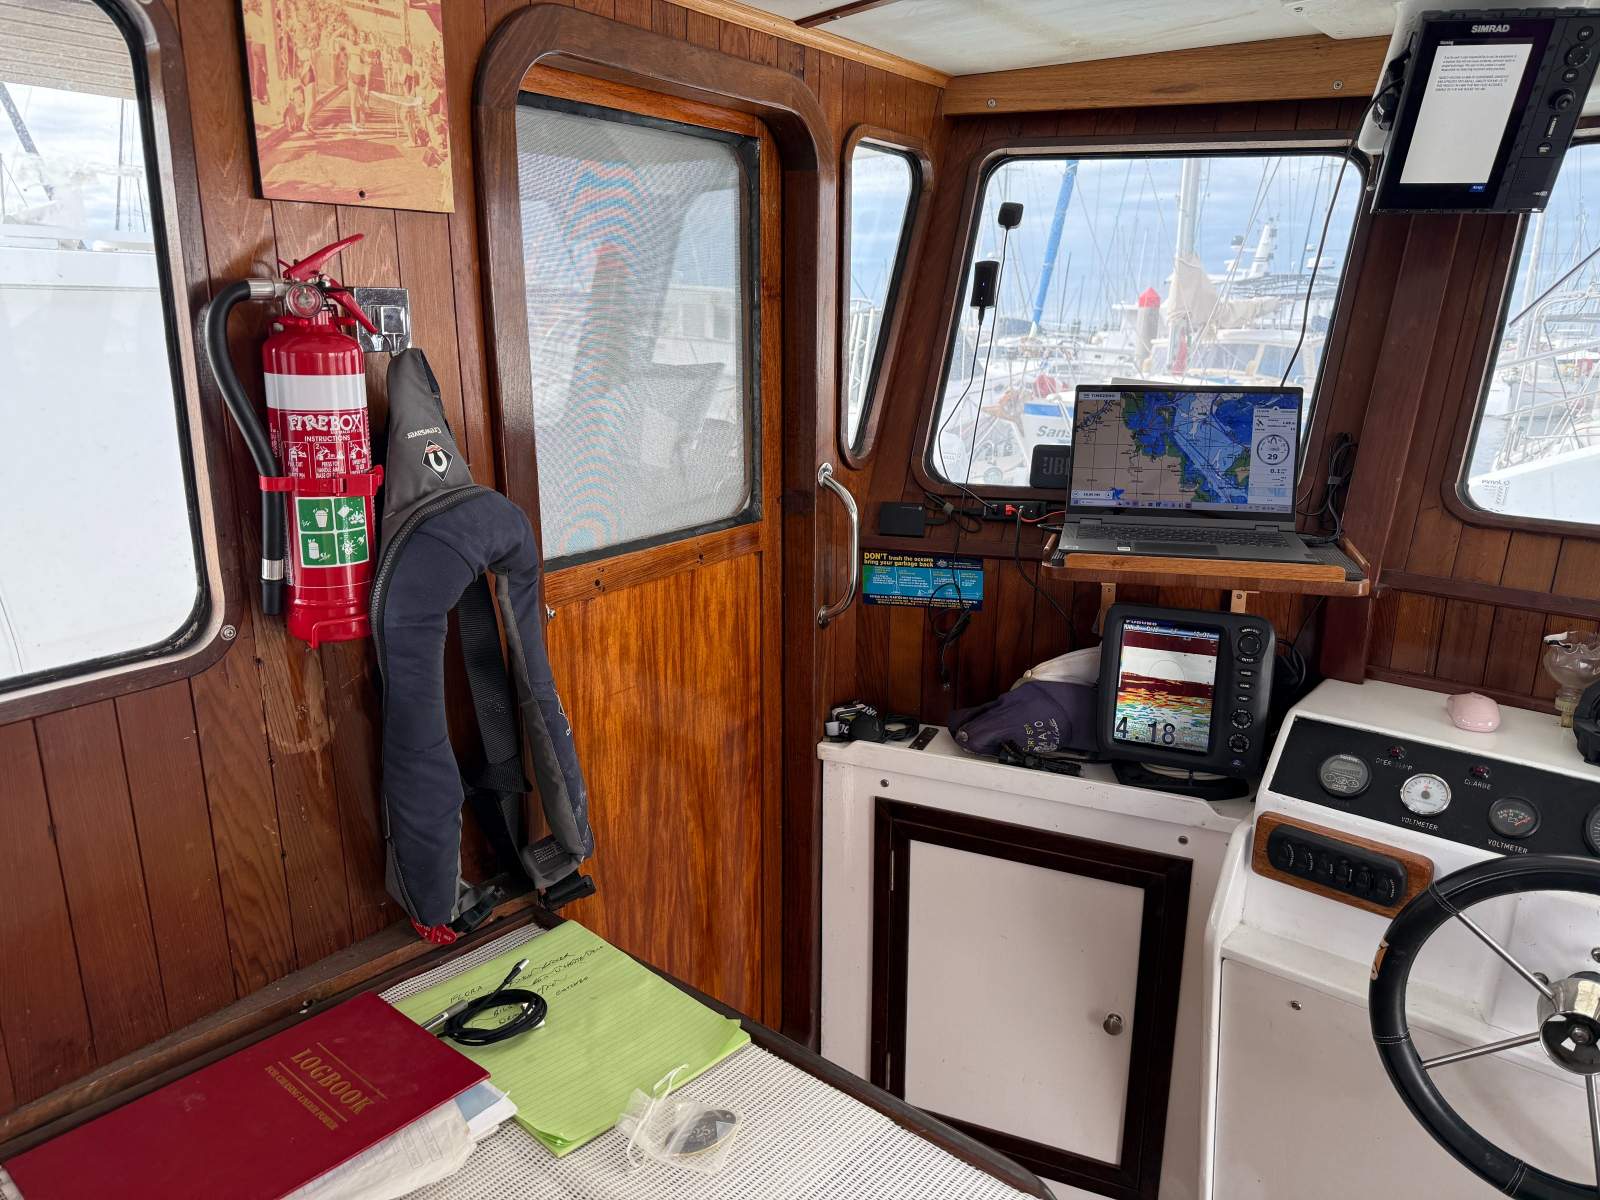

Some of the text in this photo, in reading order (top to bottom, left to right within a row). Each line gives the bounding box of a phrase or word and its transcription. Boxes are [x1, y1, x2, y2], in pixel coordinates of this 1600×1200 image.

[1471, 24, 1510, 33] SIMRAD
[287, 414, 362, 431] FIREBOX
[304, 434, 351, 443] INSTRUCTIONS
[407, 426, 442, 439] Crewsaver
[864, 552, 888, 560] DON'T
[1401, 815, 1440, 831] VOLTMETER
[1487, 838, 1529, 855] VOLTMETER
[290, 1047, 376, 1115] LOGBOOK
